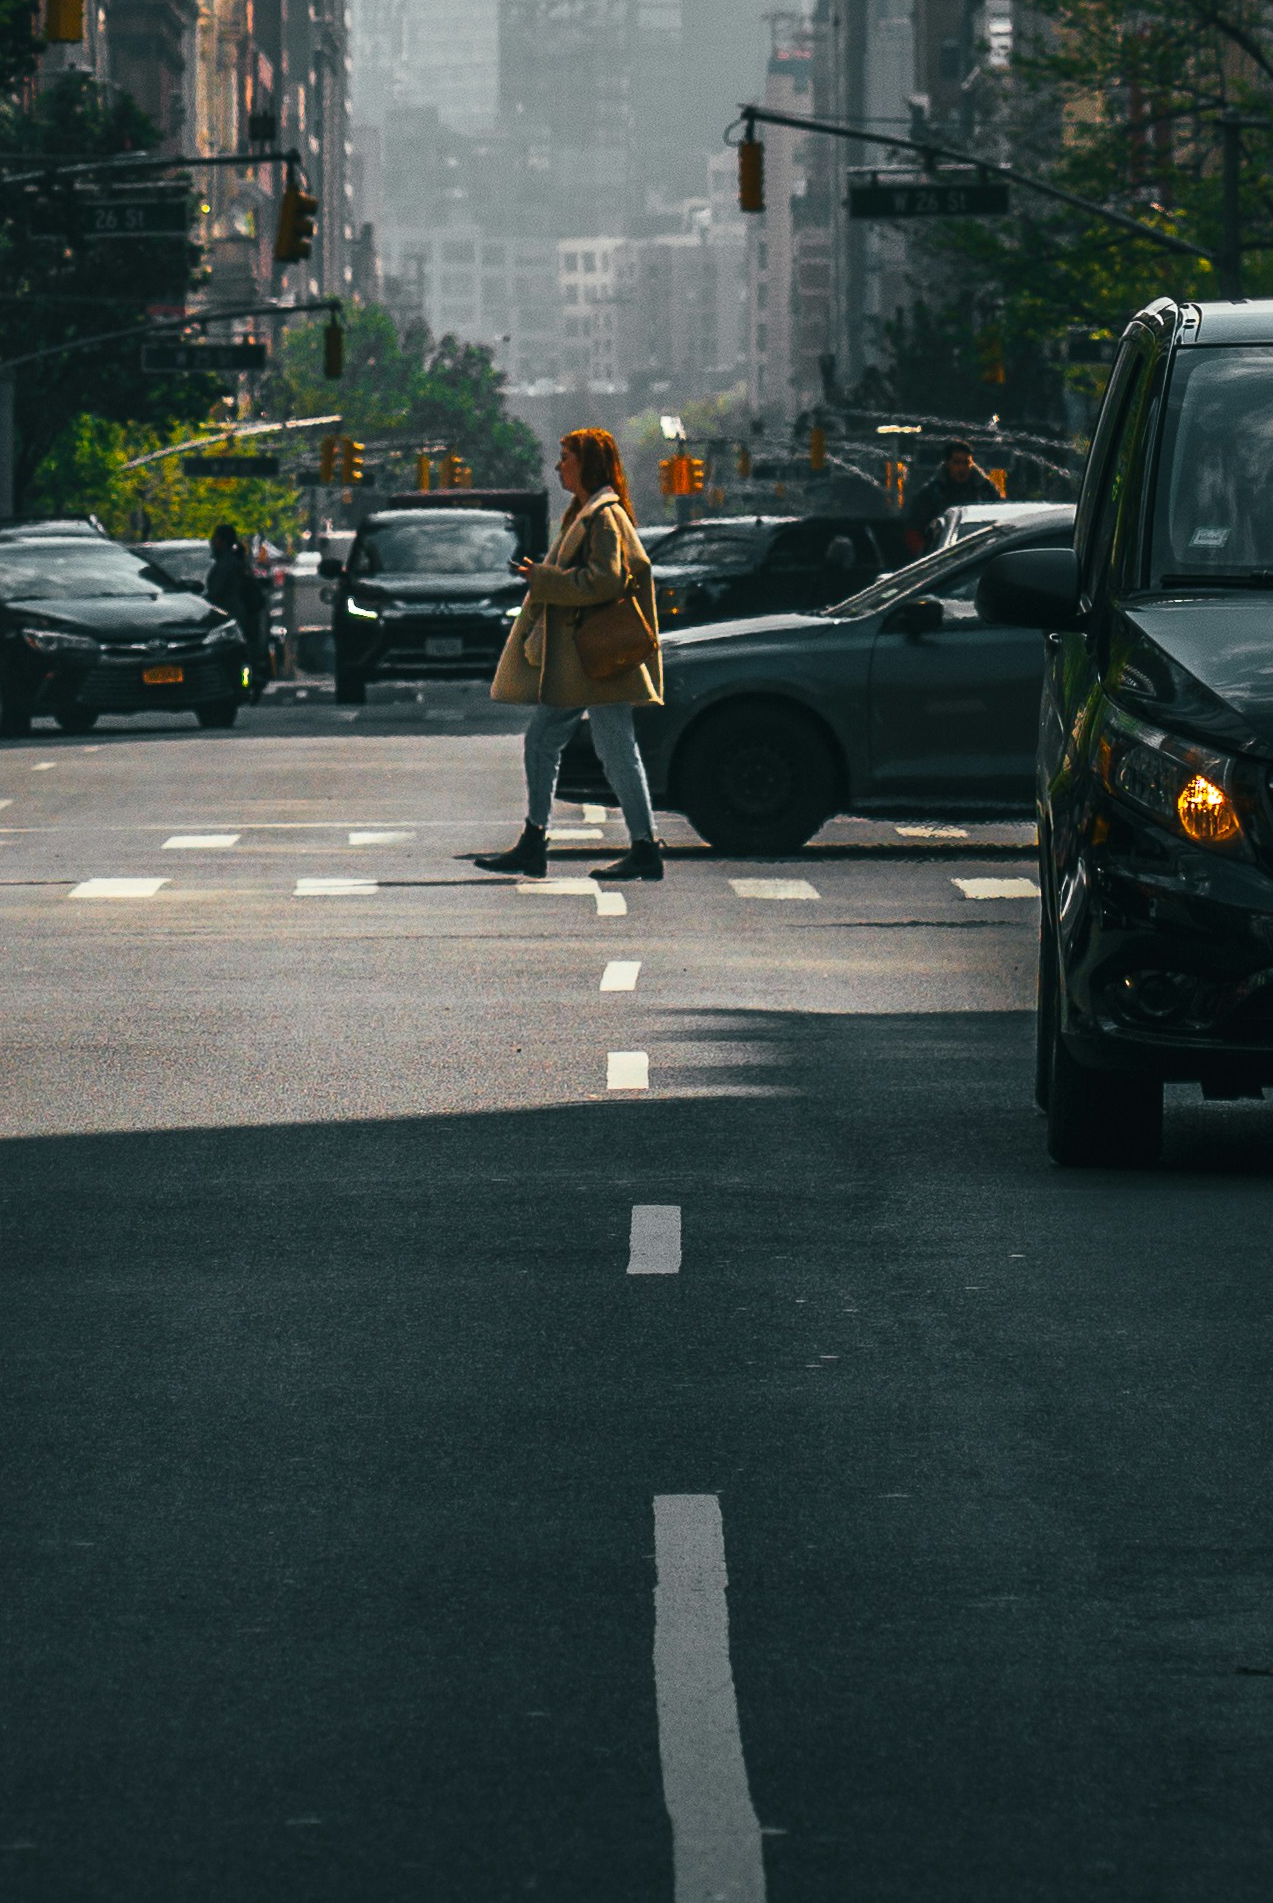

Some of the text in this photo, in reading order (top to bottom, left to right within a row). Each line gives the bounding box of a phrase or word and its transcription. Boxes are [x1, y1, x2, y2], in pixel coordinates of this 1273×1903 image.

[893, 190, 967, 212] W 26 St
[95, 208, 146, 229] 26 St
